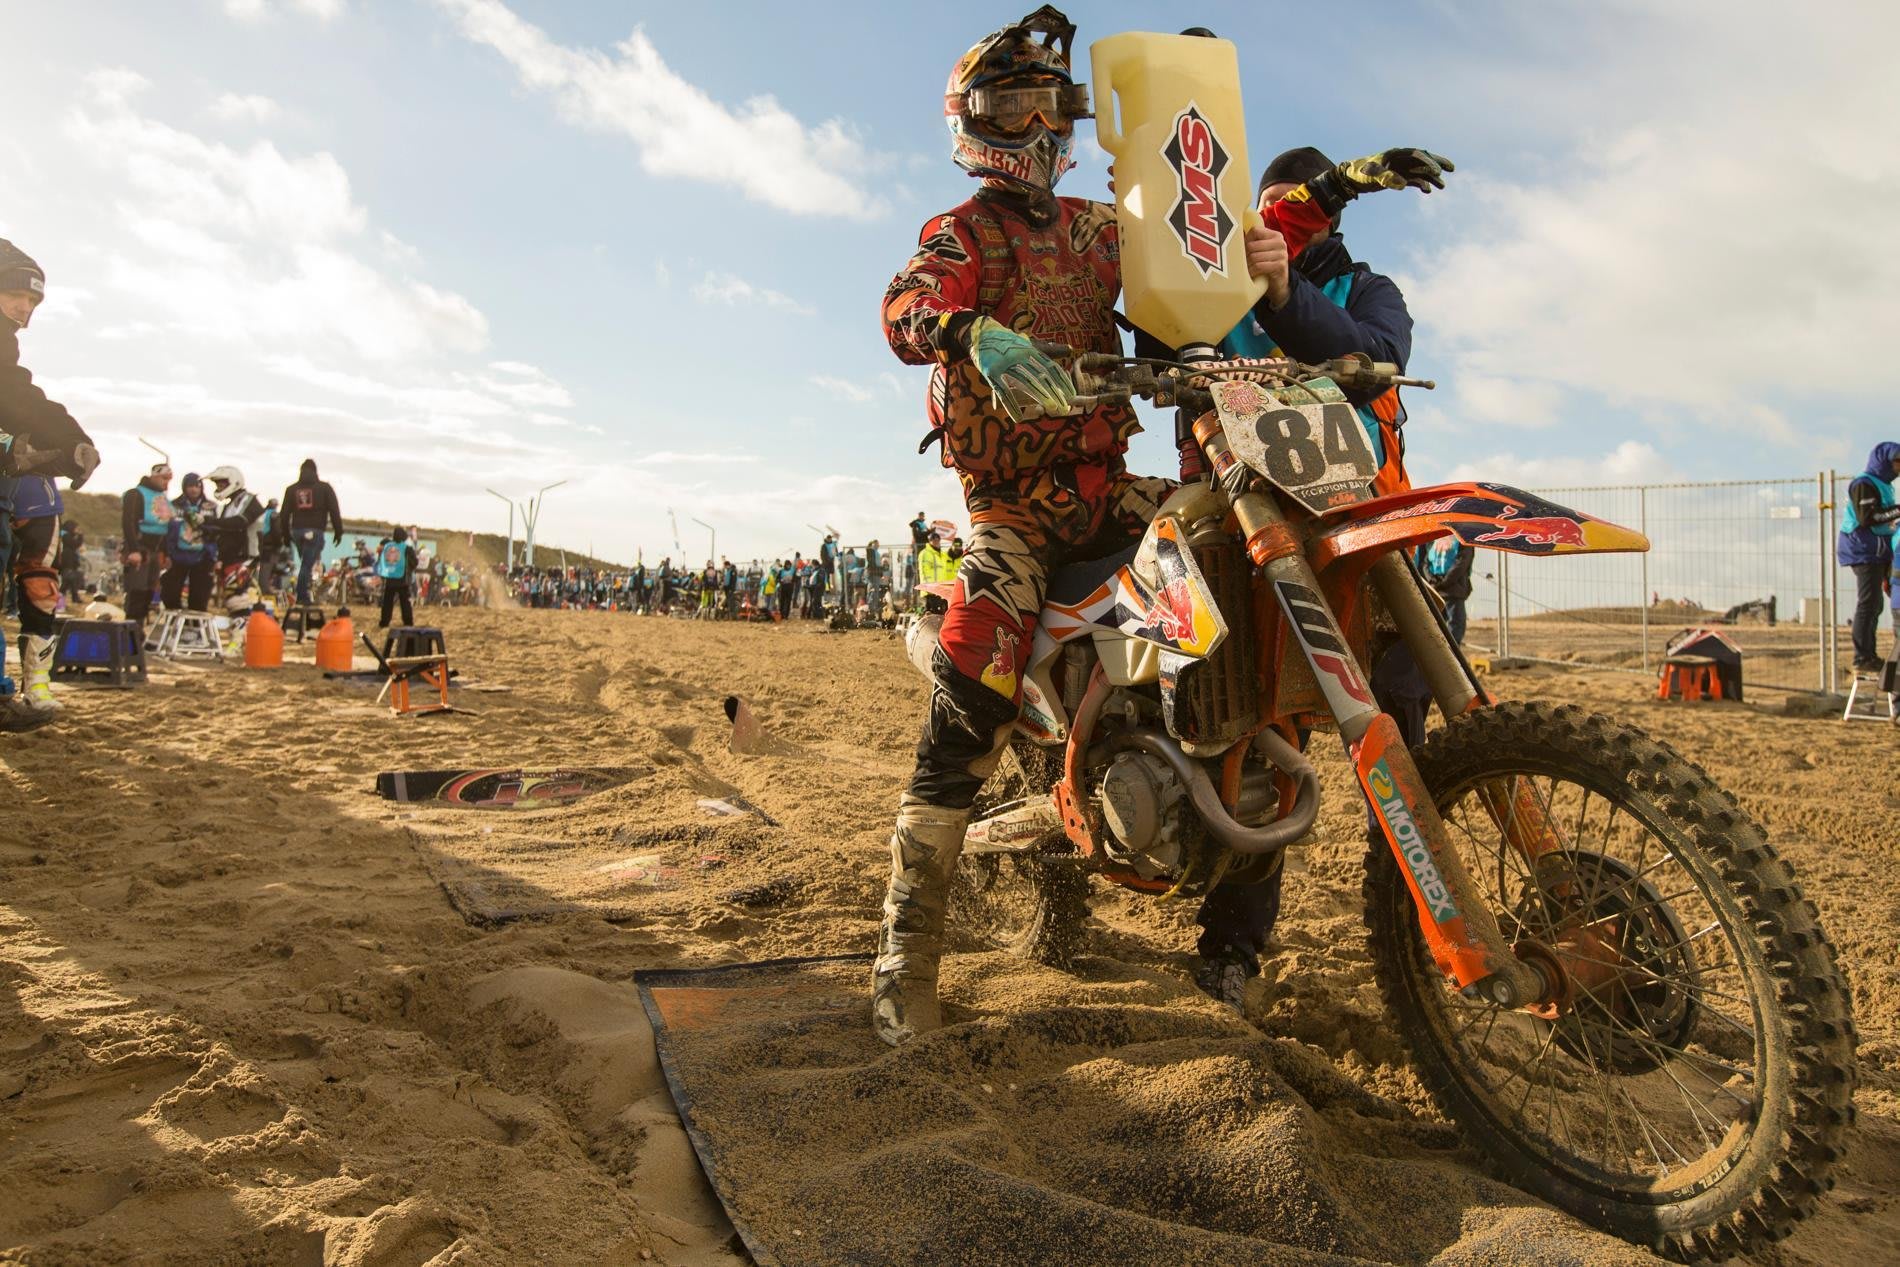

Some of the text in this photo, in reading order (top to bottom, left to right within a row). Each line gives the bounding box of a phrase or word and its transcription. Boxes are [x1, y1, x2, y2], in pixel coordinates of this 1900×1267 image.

[959, 143, 989, 166] Red
[991, 148, 1033, 181] Bull
[1177, 113, 1223, 272] IMS
[1028, 278, 1096, 303] Red Bull
[1031, 302, 1104, 340] KNOCK
[1255, 404, 1375, 487] 84
[1348, 480, 1365, 490] BAY
[1276, 580, 1373, 706] WP
[1024, 705, 1056, 732] MOTOR
[1382, 797, 1456, 918] MOTOREX
[1698, 1159, 1731, 1190] EXCEL
